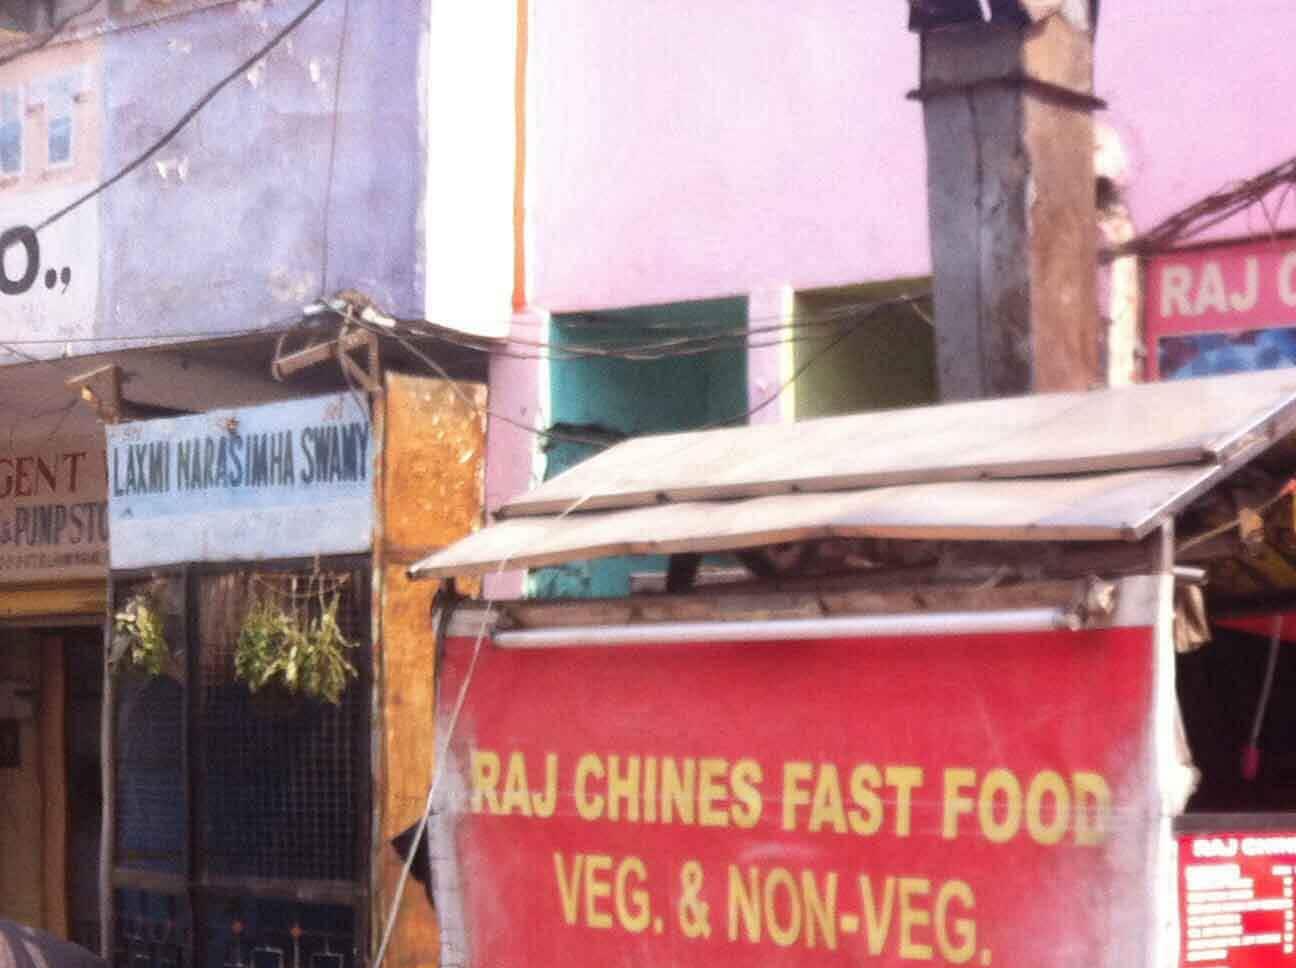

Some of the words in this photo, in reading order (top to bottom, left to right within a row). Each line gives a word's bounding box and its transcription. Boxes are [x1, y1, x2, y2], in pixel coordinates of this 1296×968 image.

[1159, 257, 1259, 318] RAJ
[113, 440, 171, 497] LAXMI
[177, 428, 295, 491] NARASIMHA
[301, 420, 370, 485] SWAMY
[470, 749, 559, 819] RAJ
[572, 752, 764, 829] CHINES
[781, 761, 924, 838] FAST
[941, 767, 1113, 847] FOOD
[553, 851, 664, 935] VEG.
[679, 860, 713, 939] &
[727, 863, 993, 967] NON-VEG.
